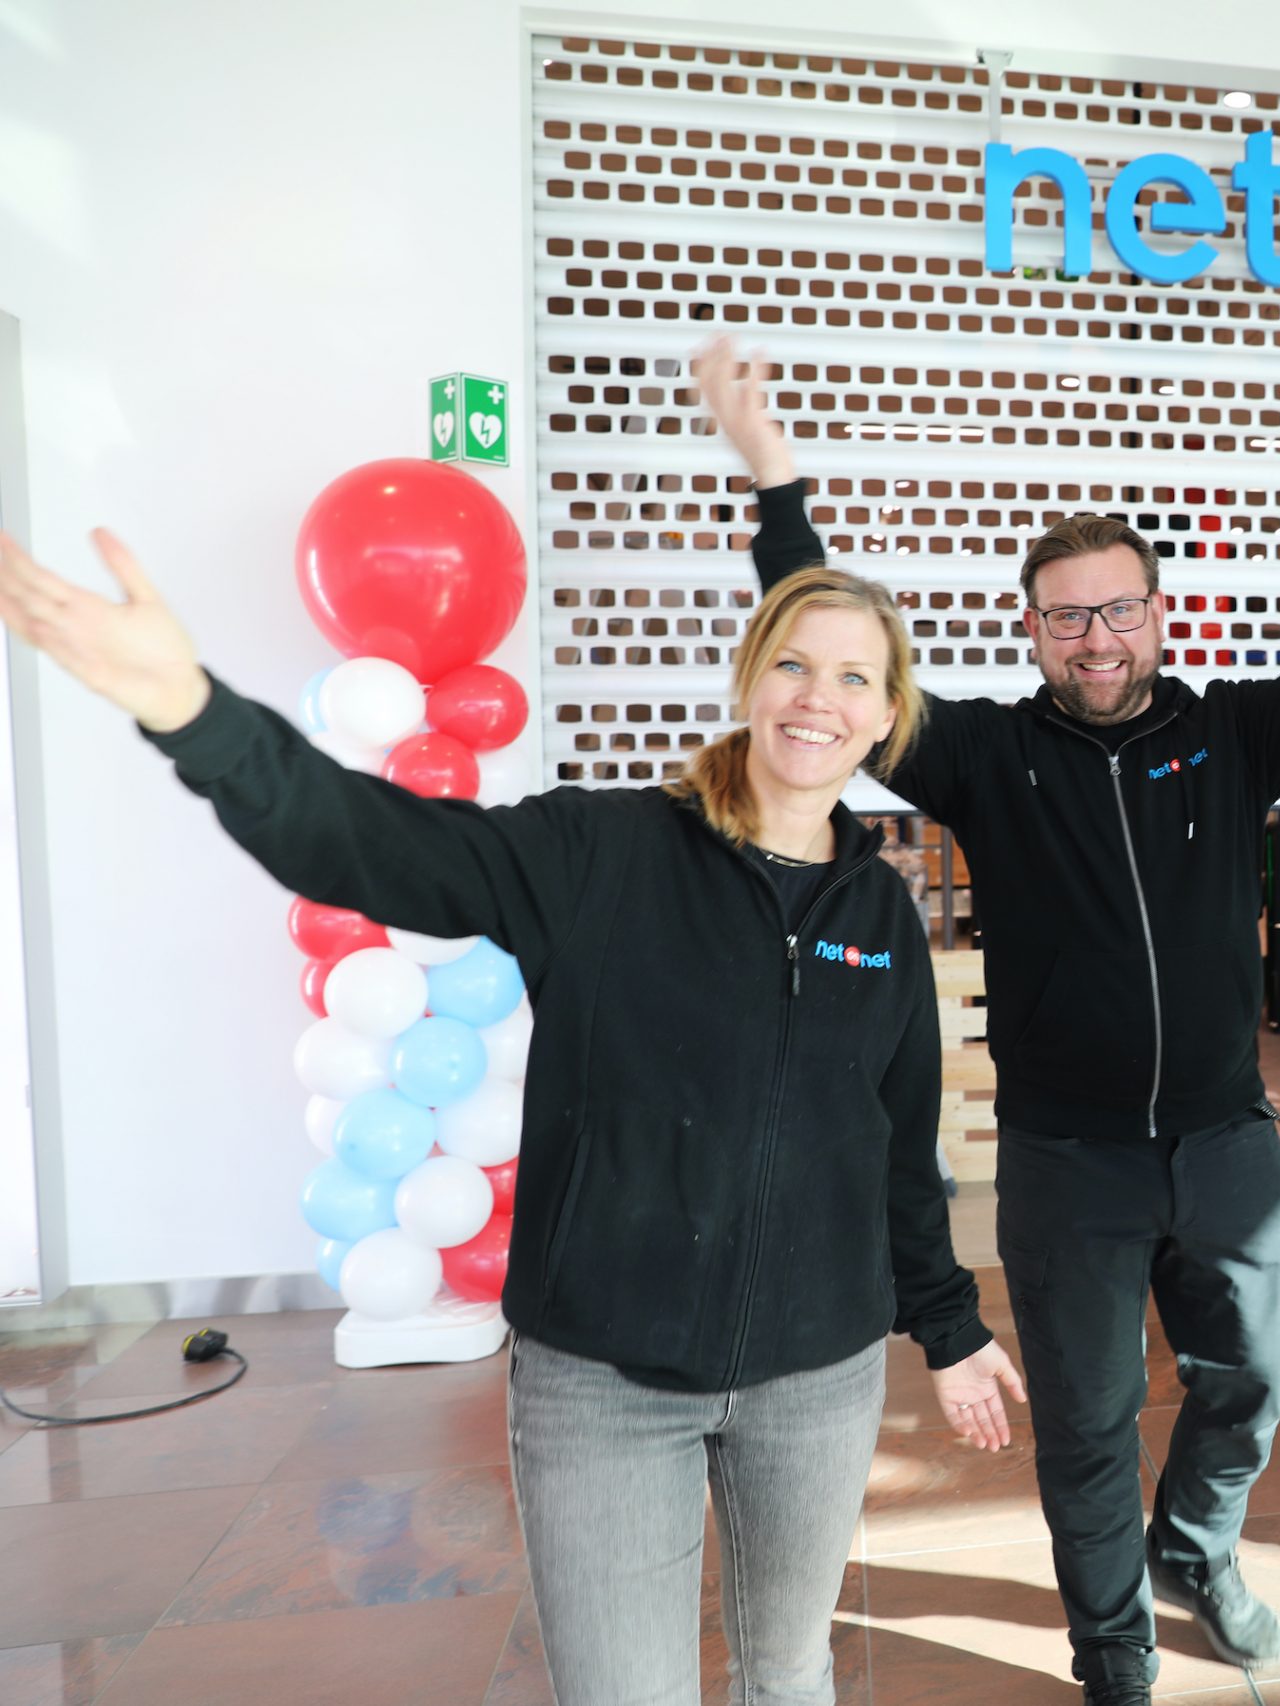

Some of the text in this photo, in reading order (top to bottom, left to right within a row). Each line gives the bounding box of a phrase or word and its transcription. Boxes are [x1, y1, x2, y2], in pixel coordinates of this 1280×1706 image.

[1148, 762, 1171, 779] net
[815, 939, 845, 962] net
[861, 950, 891, 970] net
